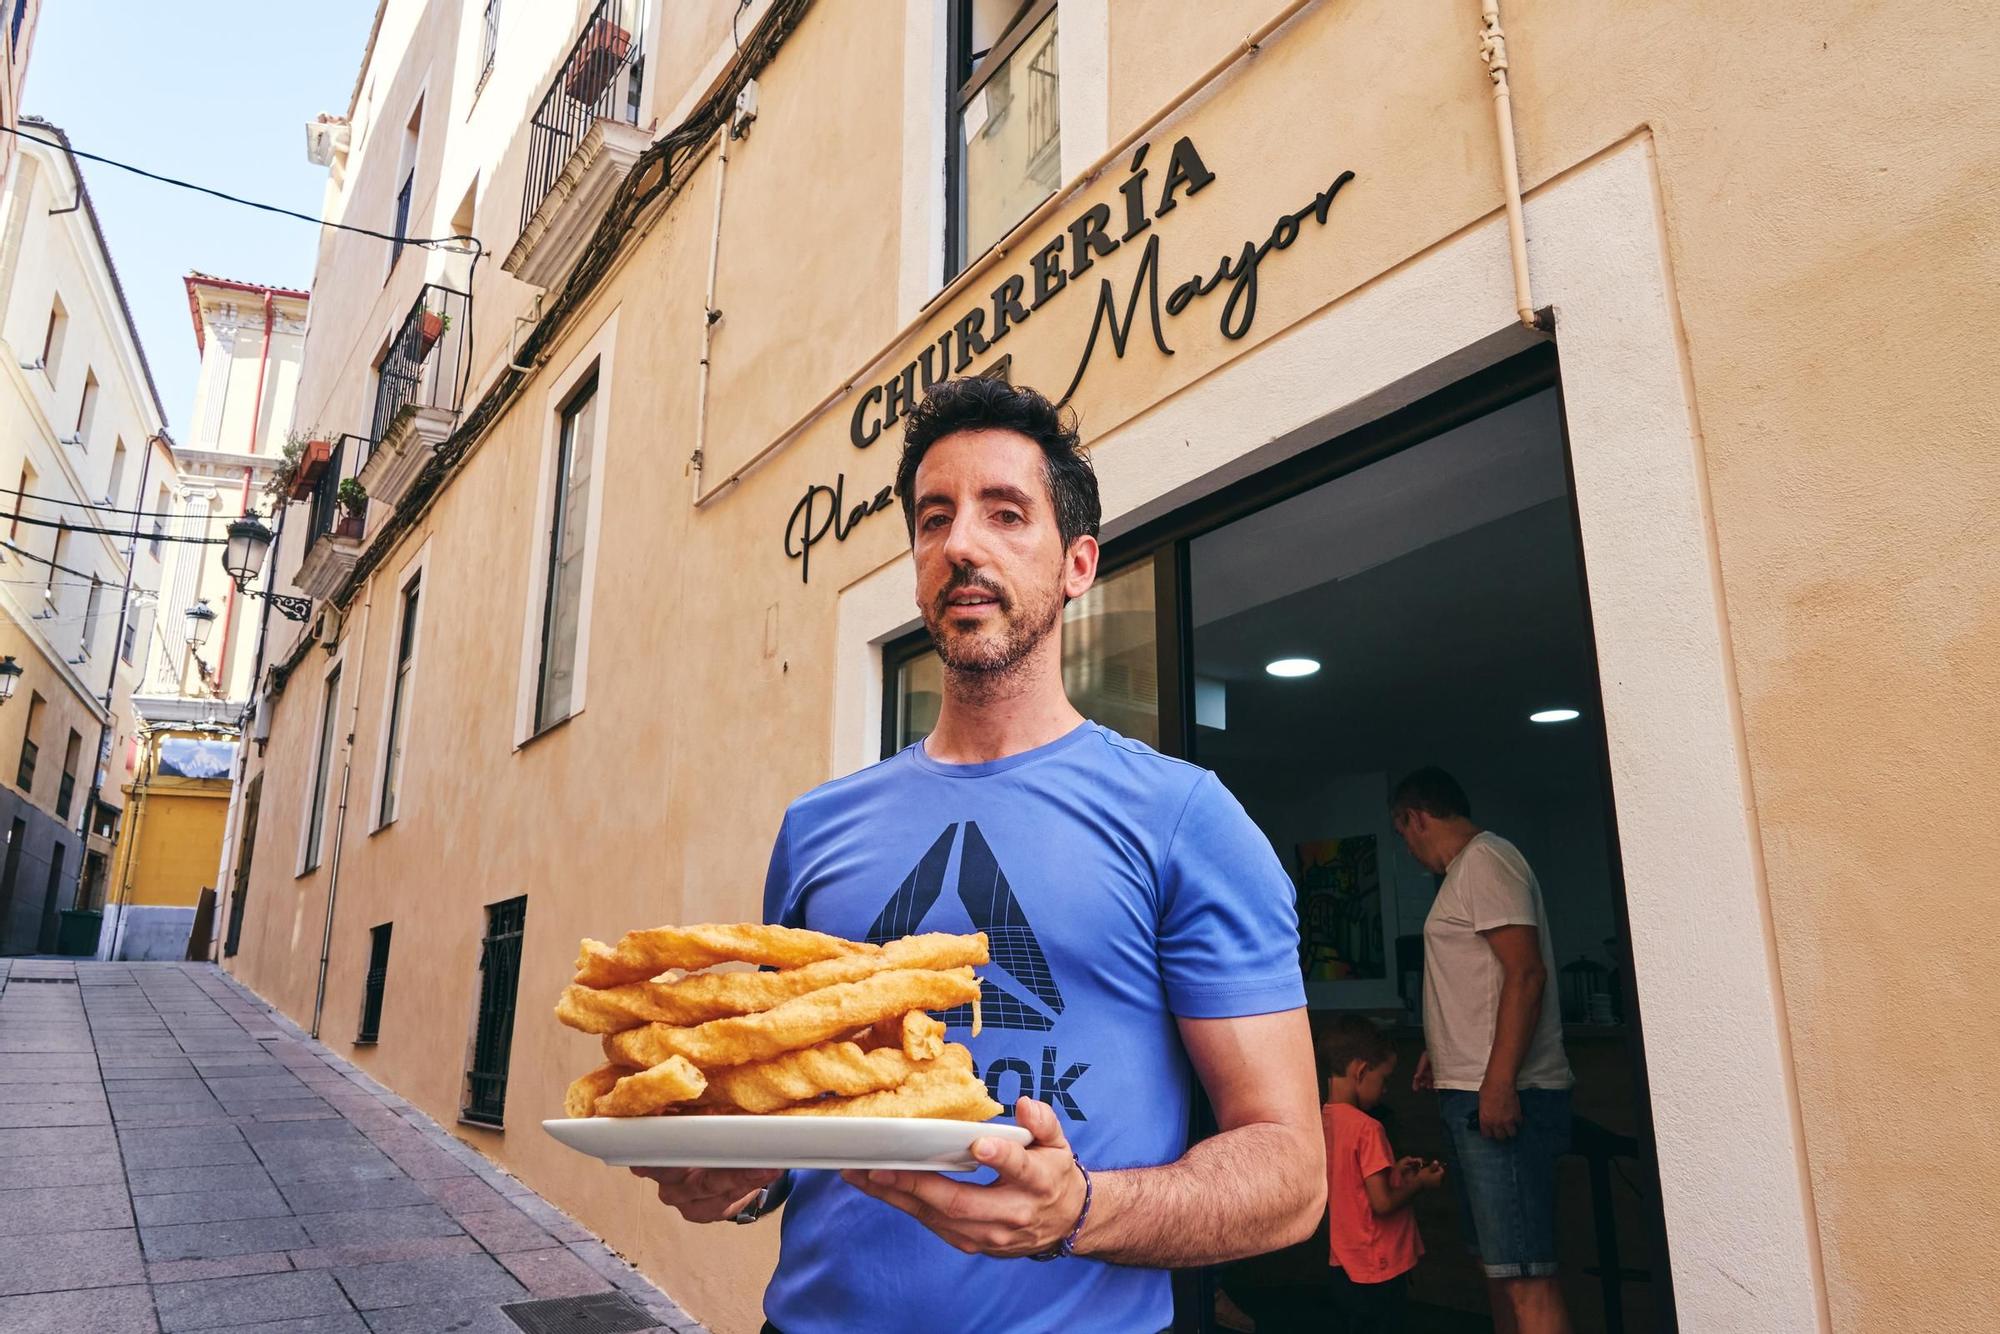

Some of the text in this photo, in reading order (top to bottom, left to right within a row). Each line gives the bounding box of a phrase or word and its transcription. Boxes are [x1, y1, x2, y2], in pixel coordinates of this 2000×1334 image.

[784, 170, 1355, 584] Plaz Mayor
[850, 136, 1215, 448] CHURRERÍA
